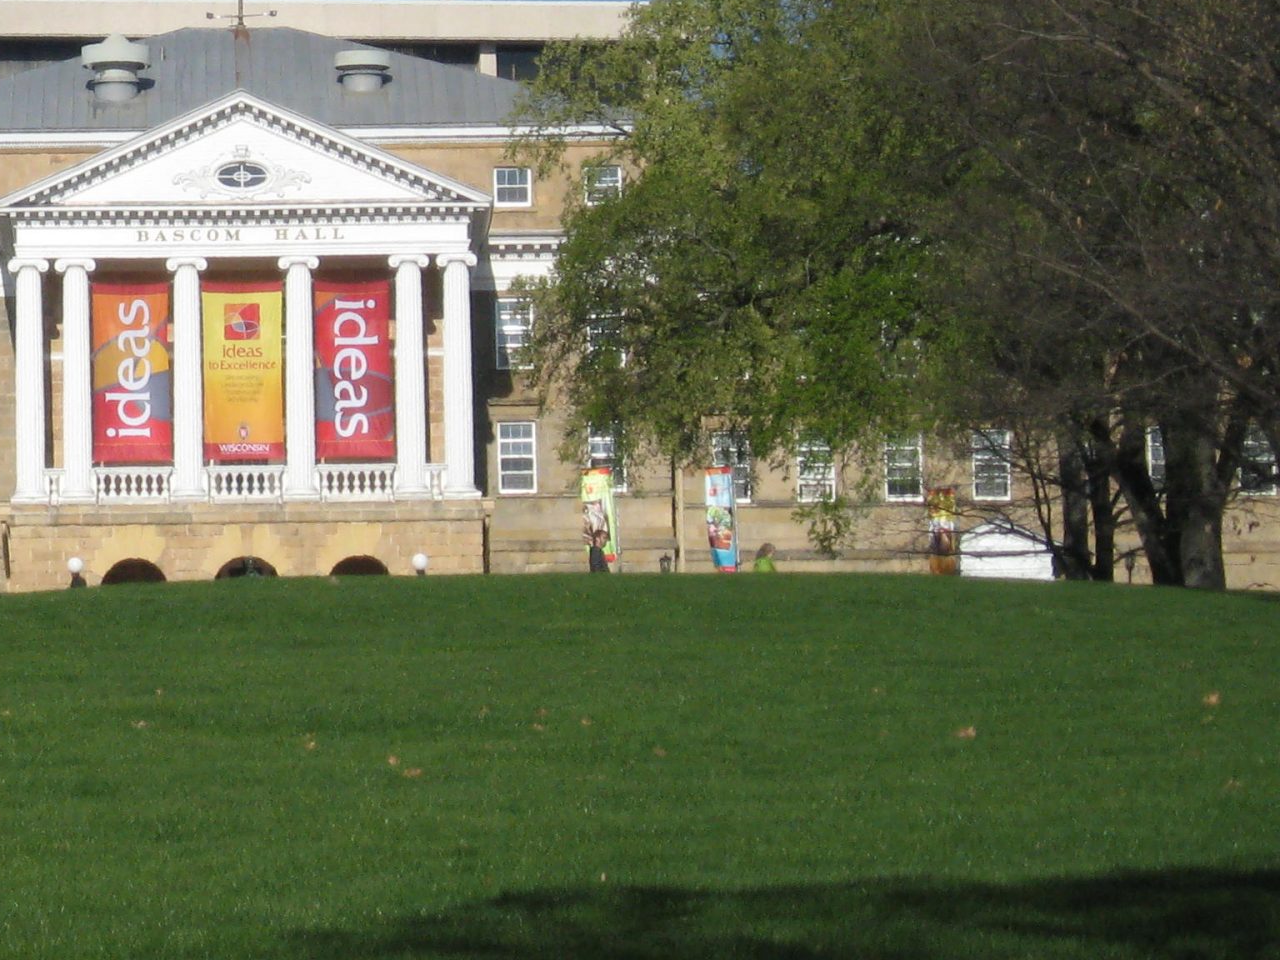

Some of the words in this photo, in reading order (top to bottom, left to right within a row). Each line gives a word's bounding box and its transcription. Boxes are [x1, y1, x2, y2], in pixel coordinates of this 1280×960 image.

[136, 228, 242, 242] BASCOM
[274, 227, 345, 241] HALL
[222, 343, 264, 359] ideas
[105, 298, 151, 438] ideas
[333, 298, 379, 438] ideas
[218, 443, 271, 452] WISCONSIN
